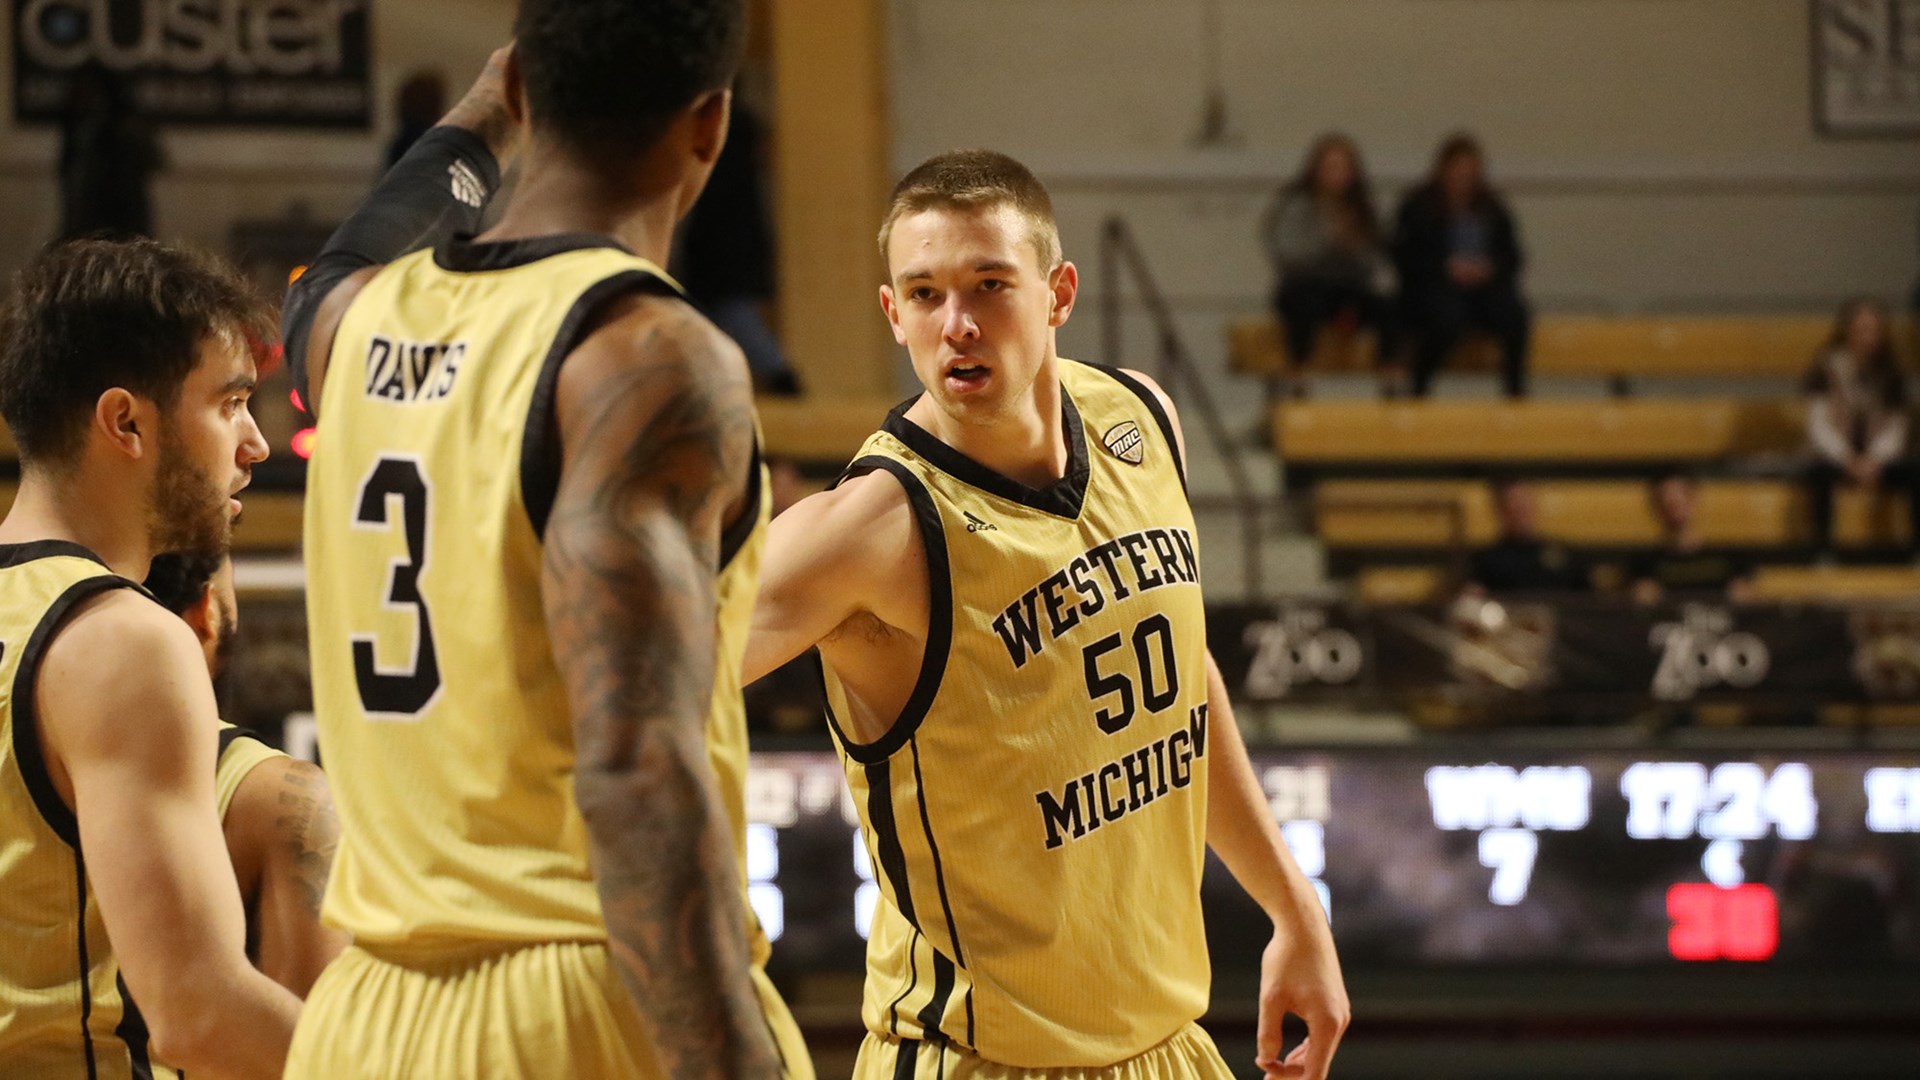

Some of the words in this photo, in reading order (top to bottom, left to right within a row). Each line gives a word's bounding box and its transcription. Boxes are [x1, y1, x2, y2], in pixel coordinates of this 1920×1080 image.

[365, 336, 466, 403] DAVIS
[1110, 428, 1141, 457] MAC
[350, 454, 443, 719] 3
[992, 528, 1199, 669] WESTERN
[1082, 613, 1179, 735] 50
[1035, 702, 1208, 850] MICHIGN
[1478, 828, 1538, 906] 7
